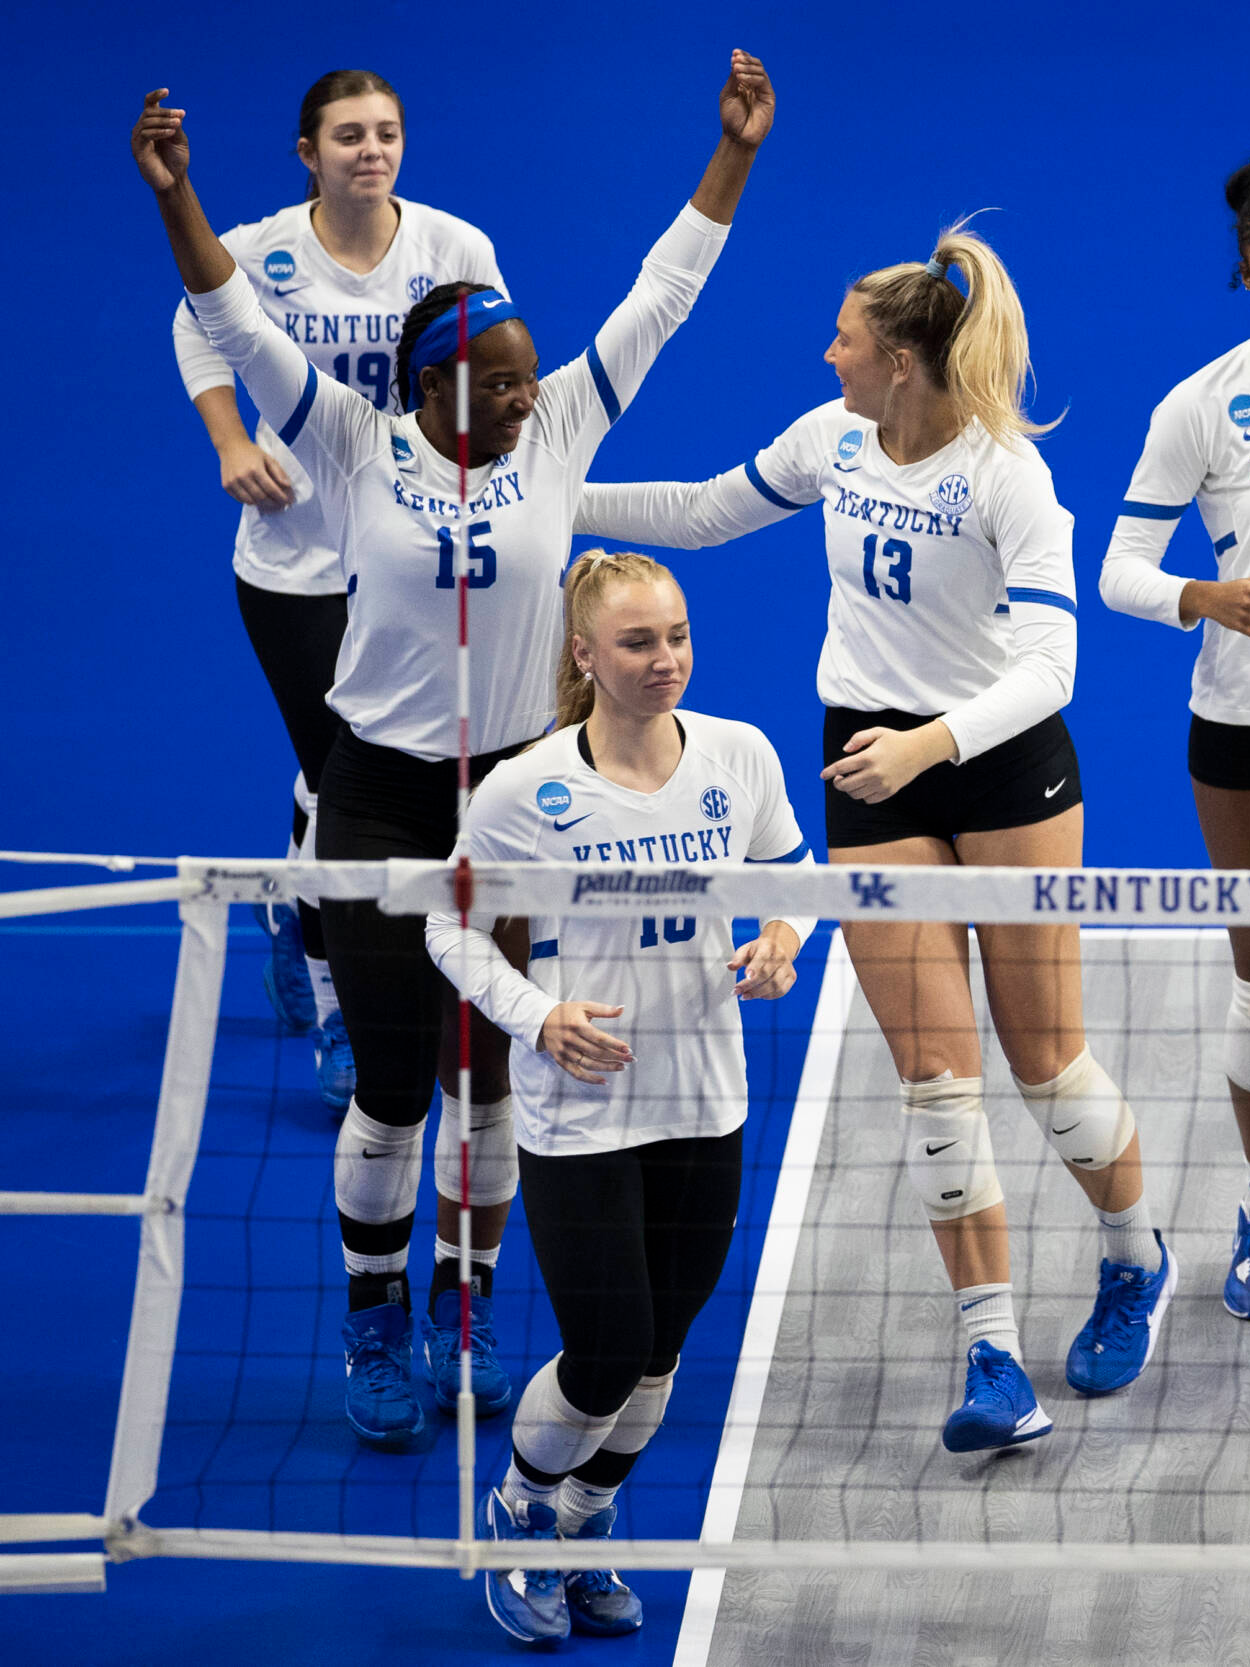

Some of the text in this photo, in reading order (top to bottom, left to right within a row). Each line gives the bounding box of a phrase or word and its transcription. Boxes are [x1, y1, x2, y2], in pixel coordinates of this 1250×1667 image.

[285, 313, 405, 343] KENTUC
[333, 352, 390, 412] 19
[940, 476, 968, 504] SEC
[835, 485, 962, 537] KENTUCKY
[435, 520, 497, 589] 15
[863, 533, 912, 605] 13
[541, 795, 569, 807] NCAA
[702, 788, 730, 818] SEC
